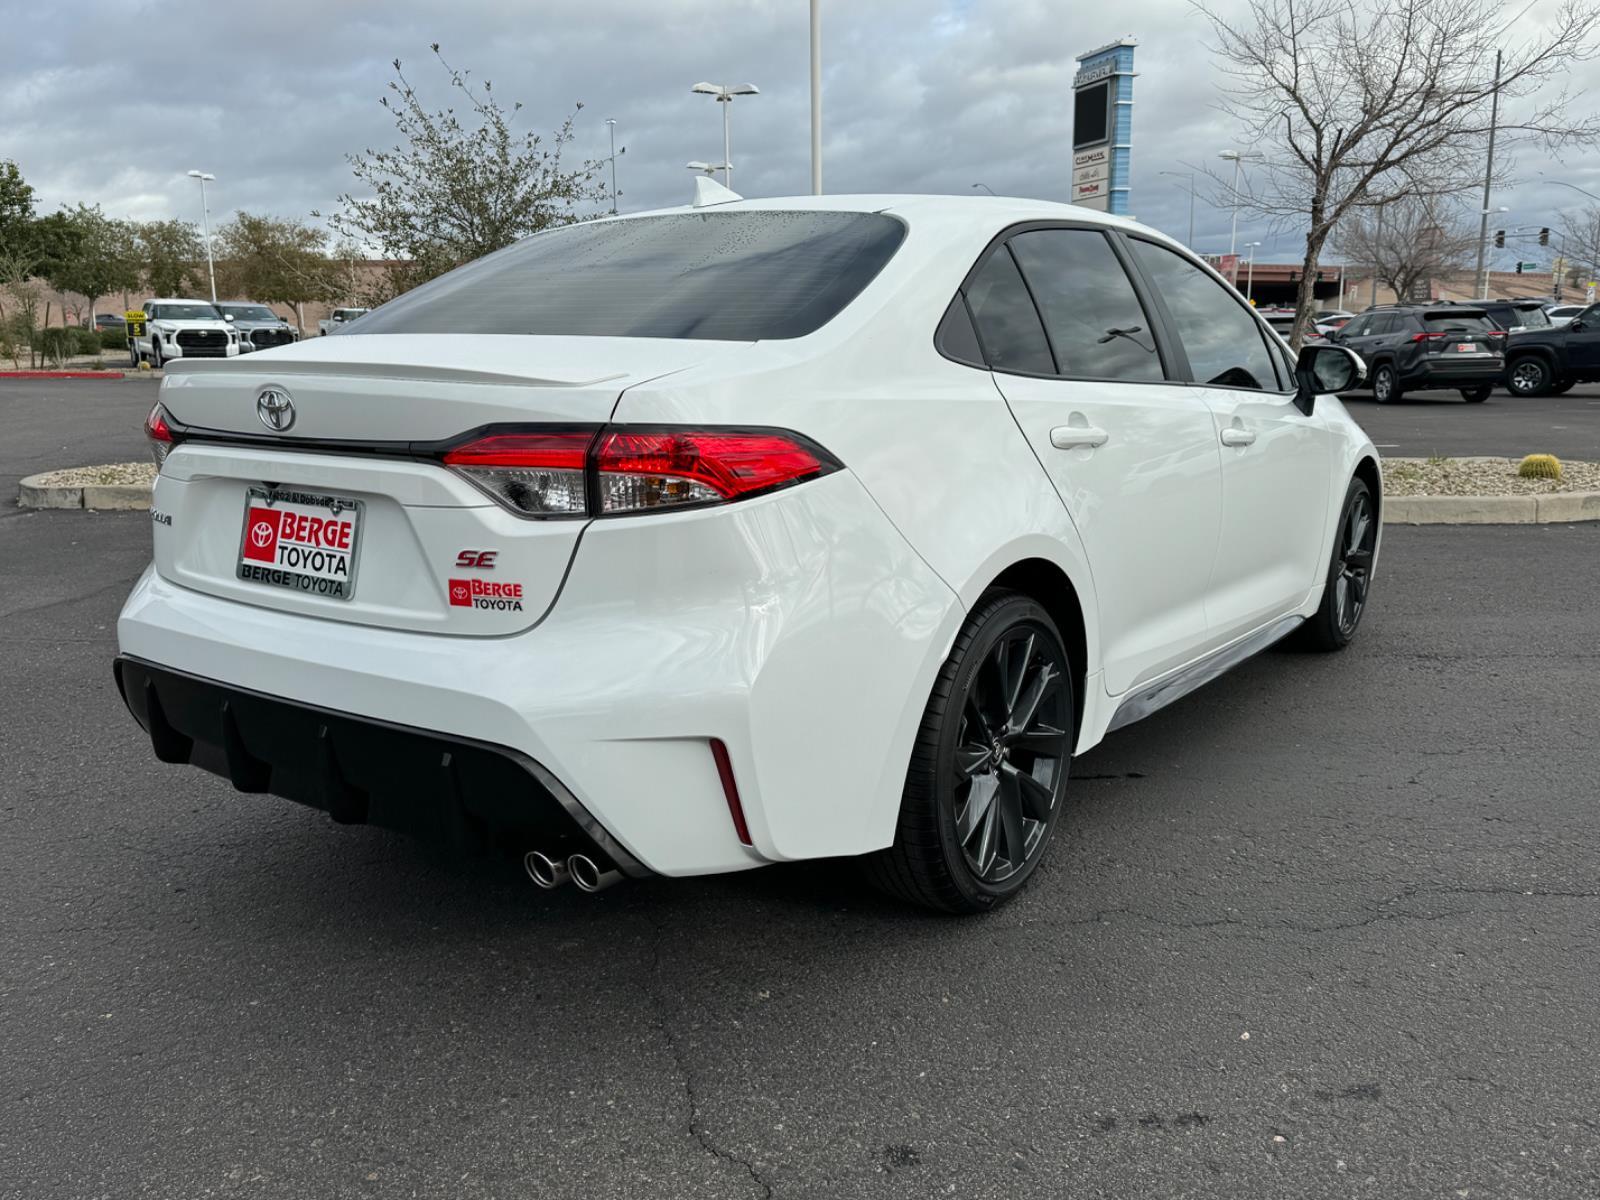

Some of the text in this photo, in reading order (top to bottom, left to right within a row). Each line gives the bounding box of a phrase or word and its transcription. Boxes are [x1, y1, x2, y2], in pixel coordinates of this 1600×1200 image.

[134, 323, 140, 333] 5
[280, 511, 351, 549] BERGE
[278, 545, 347, 576] TOYOTA
[456, 550, 498, 569] SE
[241, 564, 344, 597] BERGE TOYOTA
[471, 579, 522, 598] BERGE
[473, 598, 523, 612] TOYOTA
